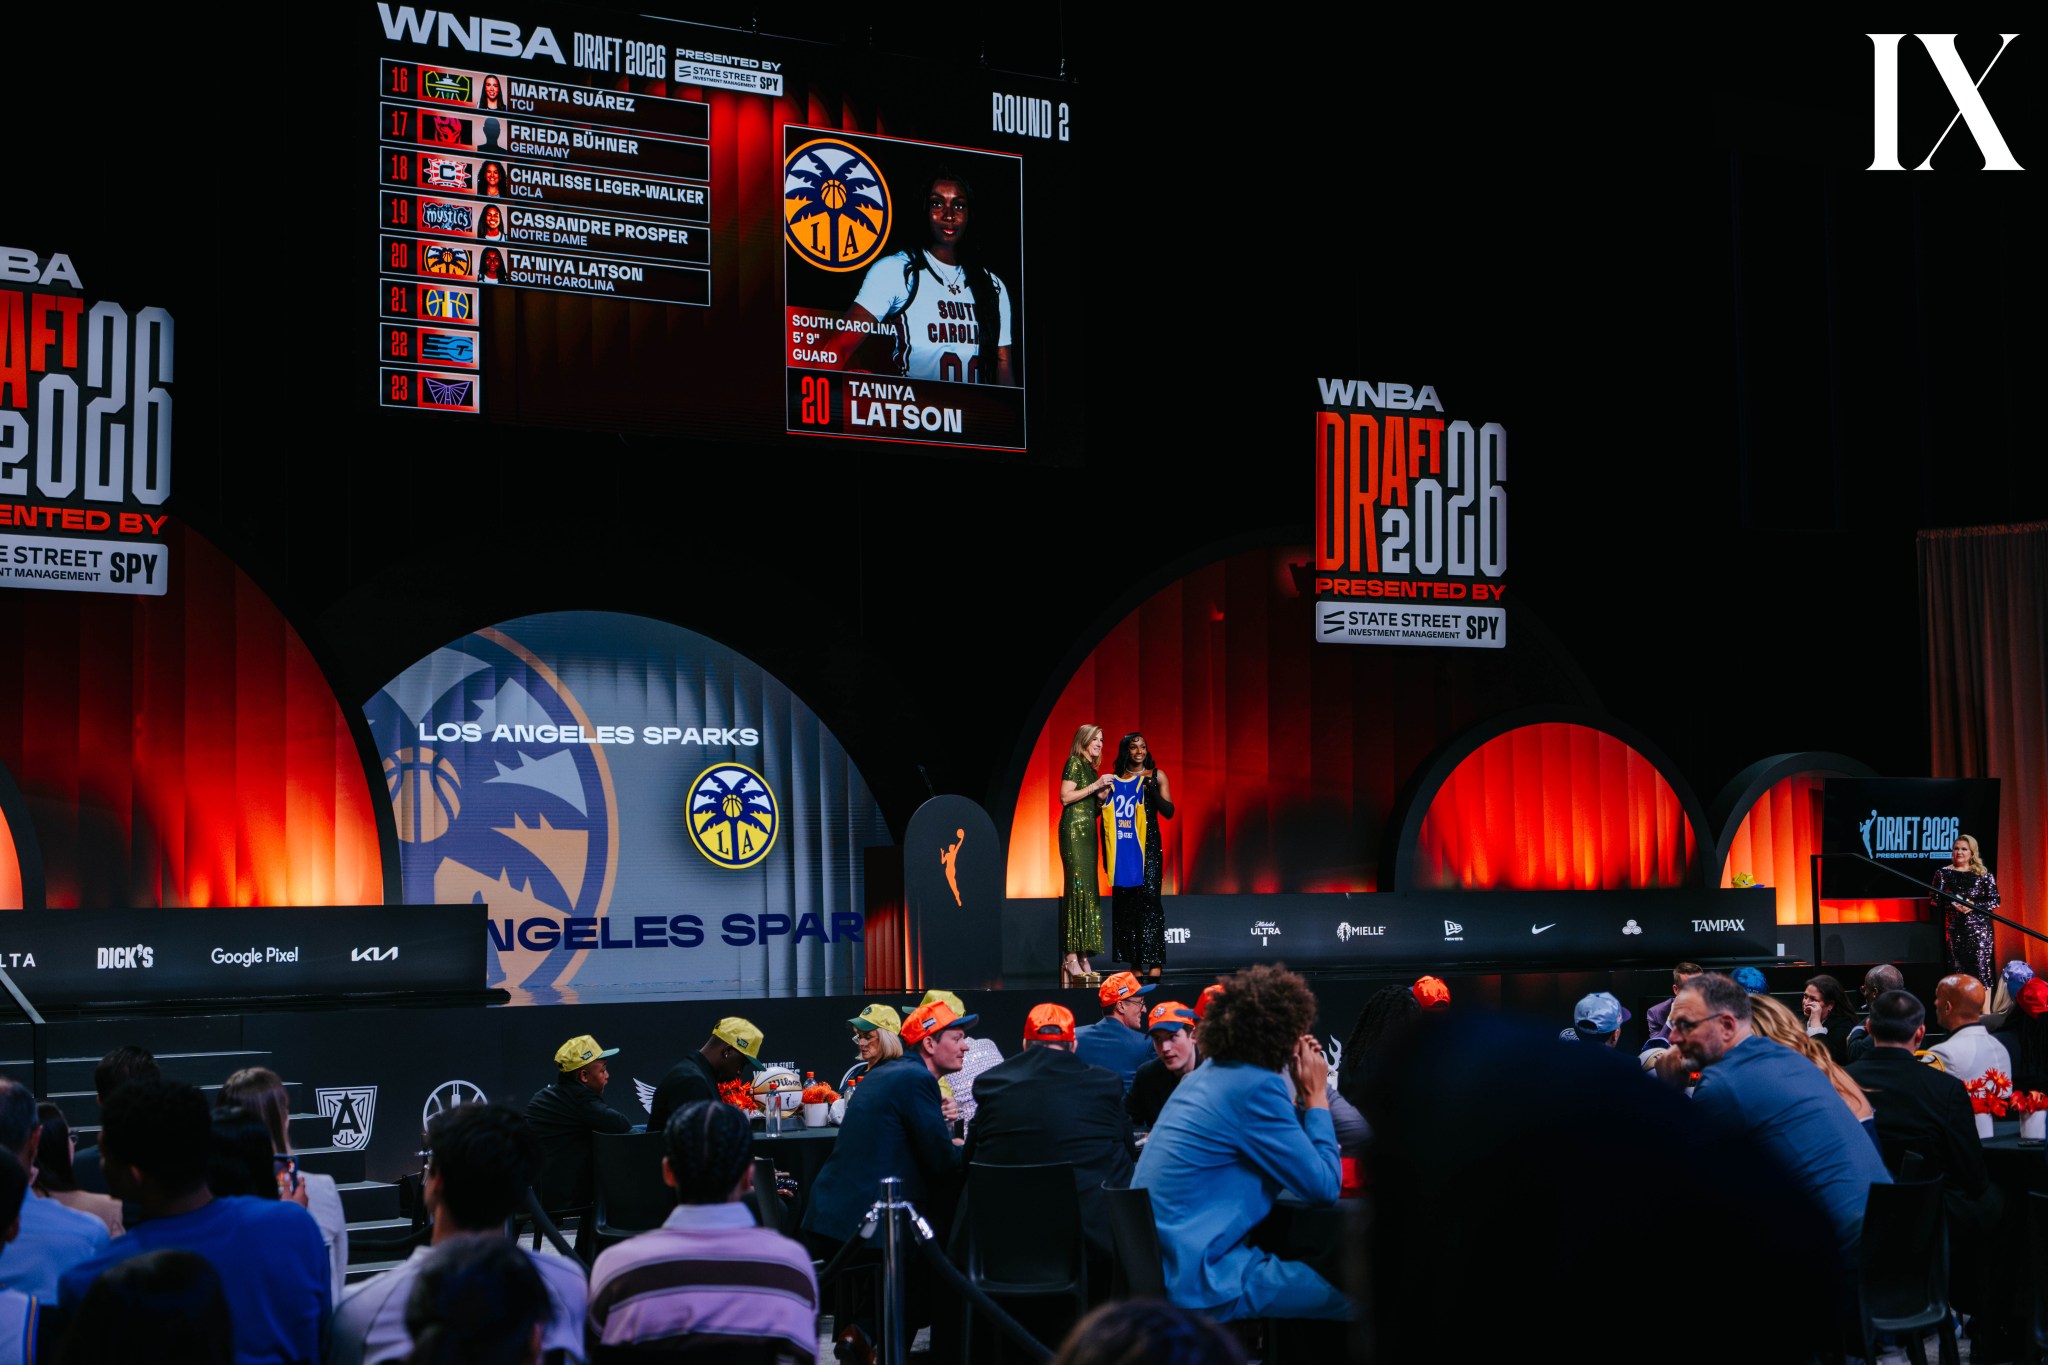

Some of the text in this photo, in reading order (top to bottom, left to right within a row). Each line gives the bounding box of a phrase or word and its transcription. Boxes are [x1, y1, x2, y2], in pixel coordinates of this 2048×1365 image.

[376, 2, 667, 79] WNBA DRAFT 2026
[676, 48, 781, 72] PRESENTED BY
[391, 67, 408, 93] 16
[693, 66, 779, 91] STATE STREET SPY
[693, 75, 756, 88] INVESTMENT MANAGEMENT
[511, 82, 635, 113] MARTA SUÁREZ
[511, 99, 534, 112] TCU
[391, 111, 408, 136] 17
[992, 92, 1069, 142] ROUND 2
[511, 124, 639, 155] FRIEDA BÜHNER
[511, 142, 570, 159] GERMANY
[391, 154, 408, 180] 18
[511, 168, 704, 206] CHARLISSE LEGER-WALKER
[511, 185, 544, 199] UCLA
[391, 198, 408, 225] 19
[511, 211, 689, 245] CASSANDRE PROSPER
[511, 228, 588, 247] NOTRE DAME
[391, 242, 408, 269] 20
[511, 254, 643, 282] TA'NIYA LATSON
[511, 271, 615, 292] SOUTH CAROLINA
[391, 286, 408, 313] 21
[937, 299, 976, 322] SOUT
[792, 315, 899, 337] SOUTH CAROLINA
[792, 332, 804, 344] 5'
[391, 331, 408, 357] 22
[792, 348, 838, 364] GUARD
[391, 374, 408, 401] 23
[848, 381, 916, 402] TA'NIYA
[1317, 377, 1445, 413] WNBA
[801, 376, 830, 426] 20
[850, 400, 963, 434] LATSON
[1315, 411, 1445, 574] DRAFT
[1381, 419, 1507, 578] 2026
[119, 512, 169, 536] BY
[14, 546, 103, 568] STREET
[110, 552, 158, 585] SPY
[14, 568, 101, 582] MANAGEMENT
[1315, 577, 1507, 601] PRESENTED BY
[1348, 611, 1499, 640] STATE STREET SPY
[1348, 629, 1460, 640] INVESTMENT MANAGEMENT
[418, 722, 760, 747] LOS ANGELES SPARKS
[1115, 794, 1136, 818] 26
[1876, 816, 1960, 851] DRAFT 2026
[1250, 927, 1281, 935] ULTRA
[1351, 925, 1386, 936] MIELLE
[1691, 919, 1745, 932] TAMPAX
[97, 943, 154, 970] DICK'S
[211, 946, 299, 968] Google Pixel
